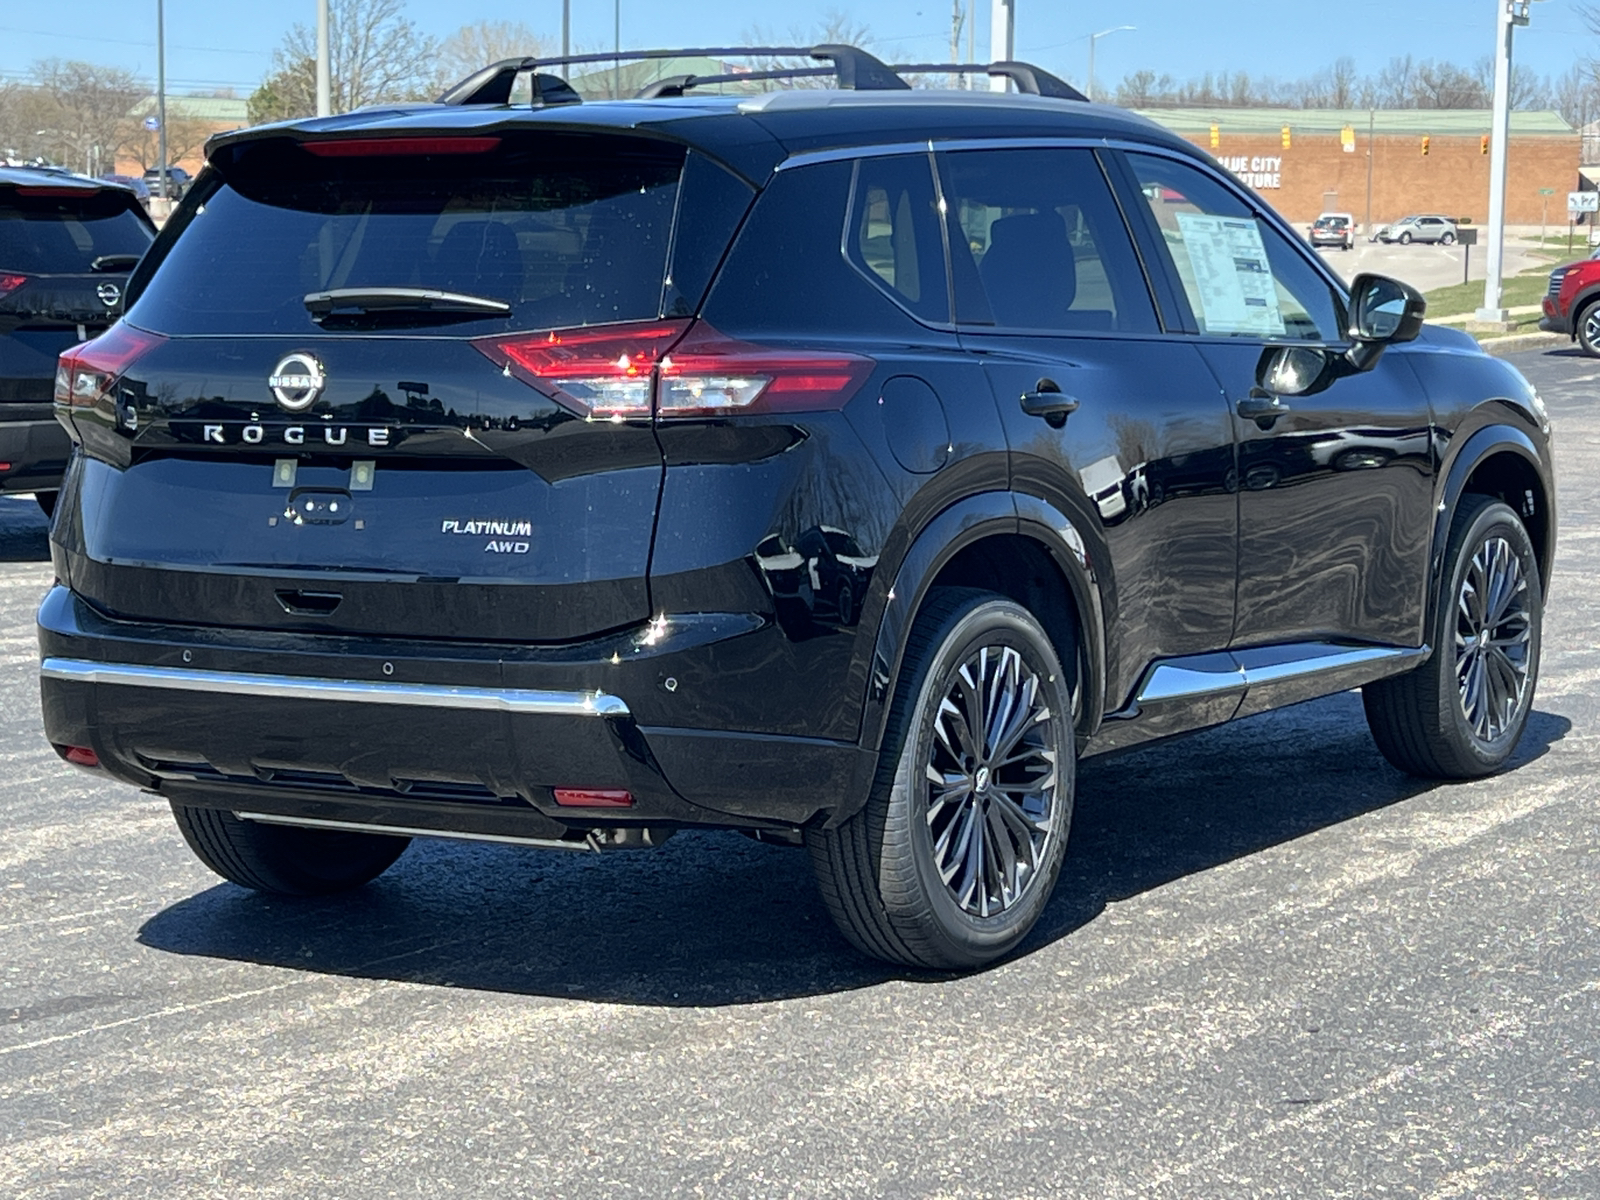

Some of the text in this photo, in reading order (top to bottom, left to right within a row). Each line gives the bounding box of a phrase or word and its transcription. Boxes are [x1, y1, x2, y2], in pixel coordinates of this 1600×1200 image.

[1251, 156, 1282, 172] CITY
[268, 375, 324, 388] NISSAN
[203, 424, 390, 446] ROGUE
[441, 520, 532, 536] PLATINUM
[484, 540, 530, 553] AWD
